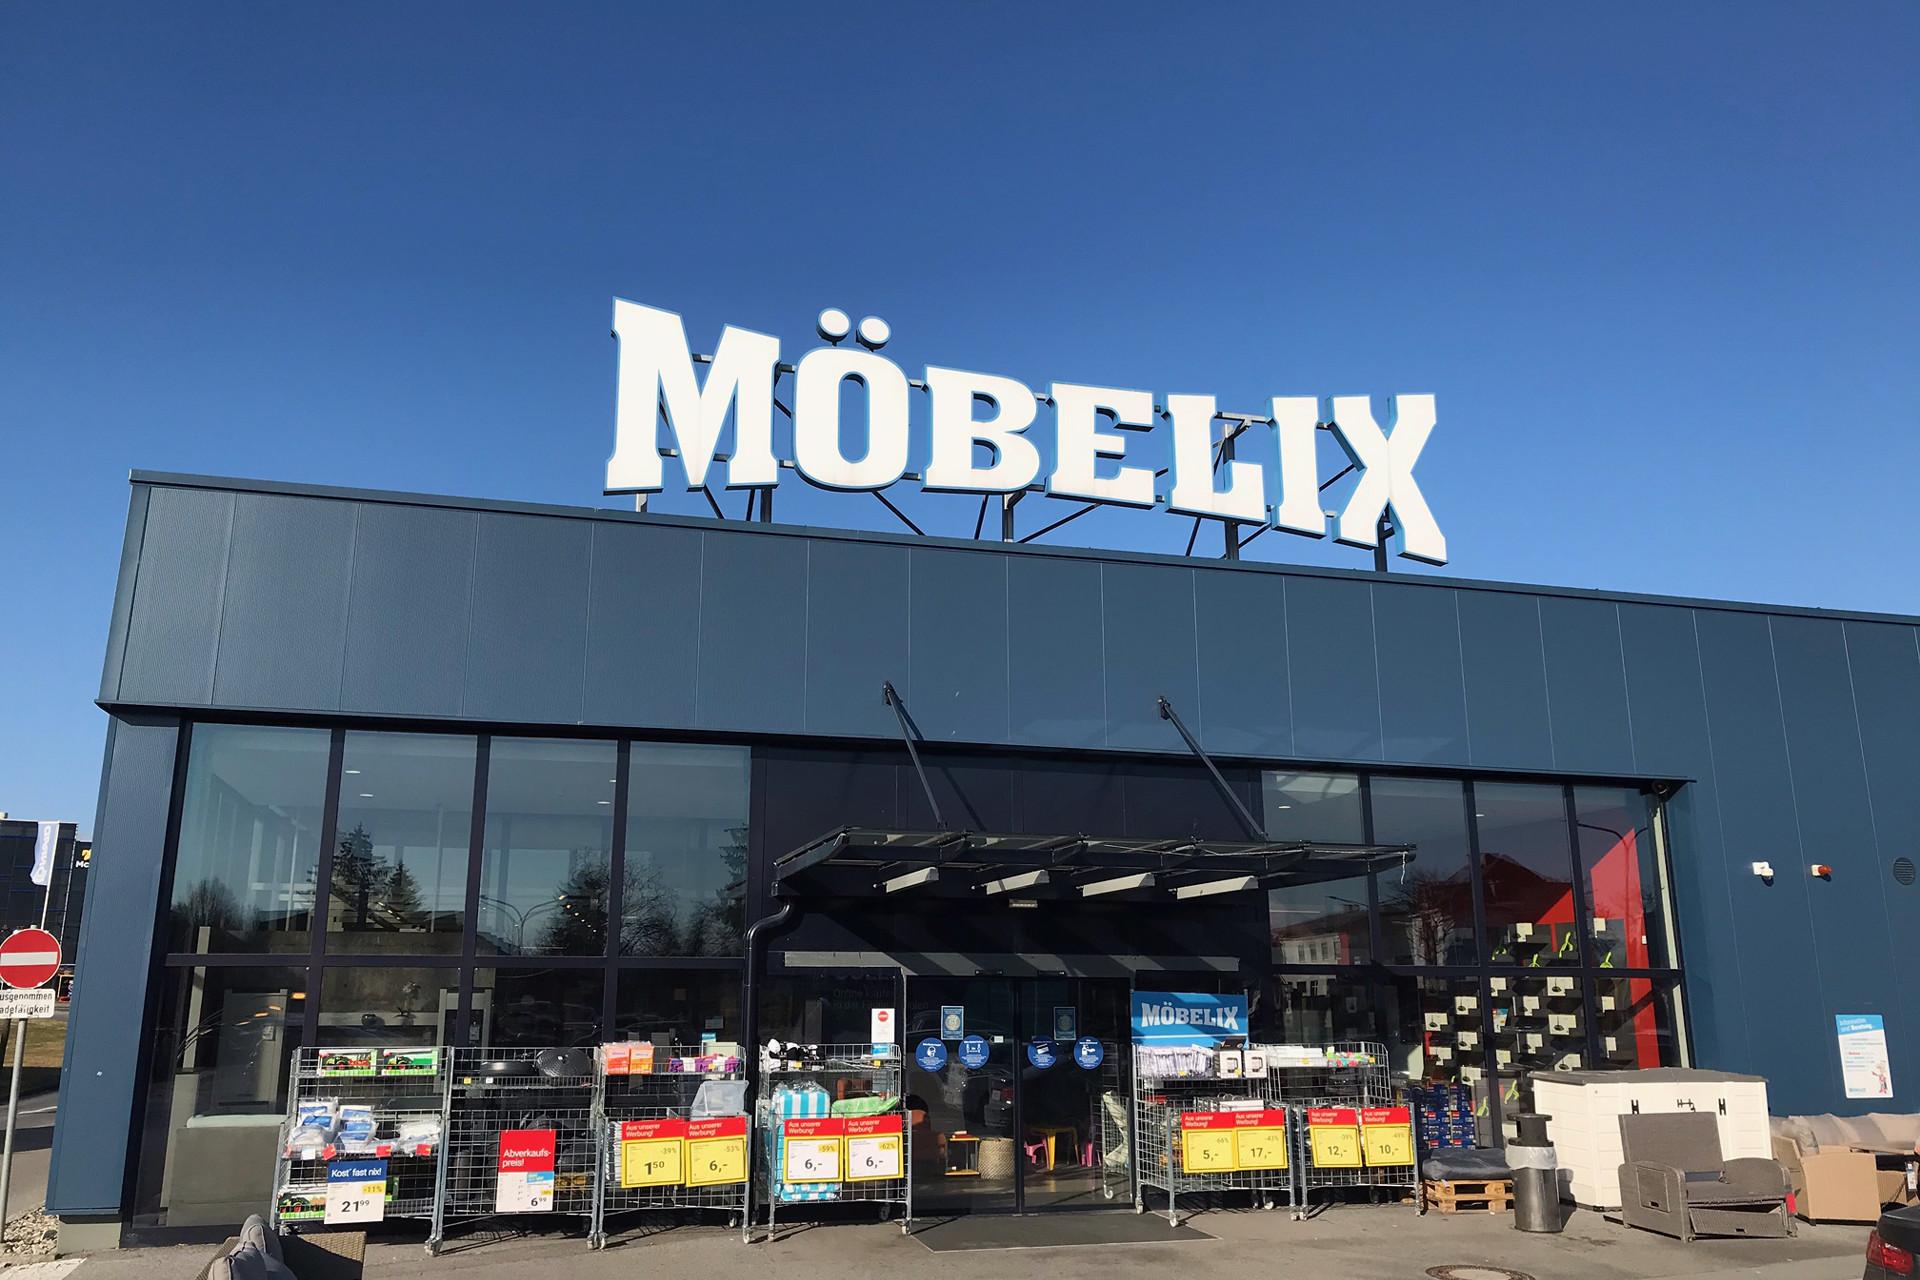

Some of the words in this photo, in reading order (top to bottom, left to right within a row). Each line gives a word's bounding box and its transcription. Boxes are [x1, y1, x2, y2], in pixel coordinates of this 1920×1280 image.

[604, 297, 1448, 563] MÖBELIX
[0, 992, 53, 1003] usgenommen
[1141, 1001, 1239, 1031] MÖBELIX
[502, 1147, 551, 1158] Abverkaufs-
[1203, 1149, 1219, 1162] 5,-
[1251, 1147, 1272, 1159] 17,-
[1328, 1145, 1347, 1157] 12,-
[1379, 1144, 1399, 1156] 10,-
[502, 1158, 525, 1169] preis!
[709, 1160, 728, 1173] 6,-
[805, 1159, 823, 1171] 6,-
[866, 1156, 884, 1168] 6,-
[352, 1168, 367, 1177] fast
